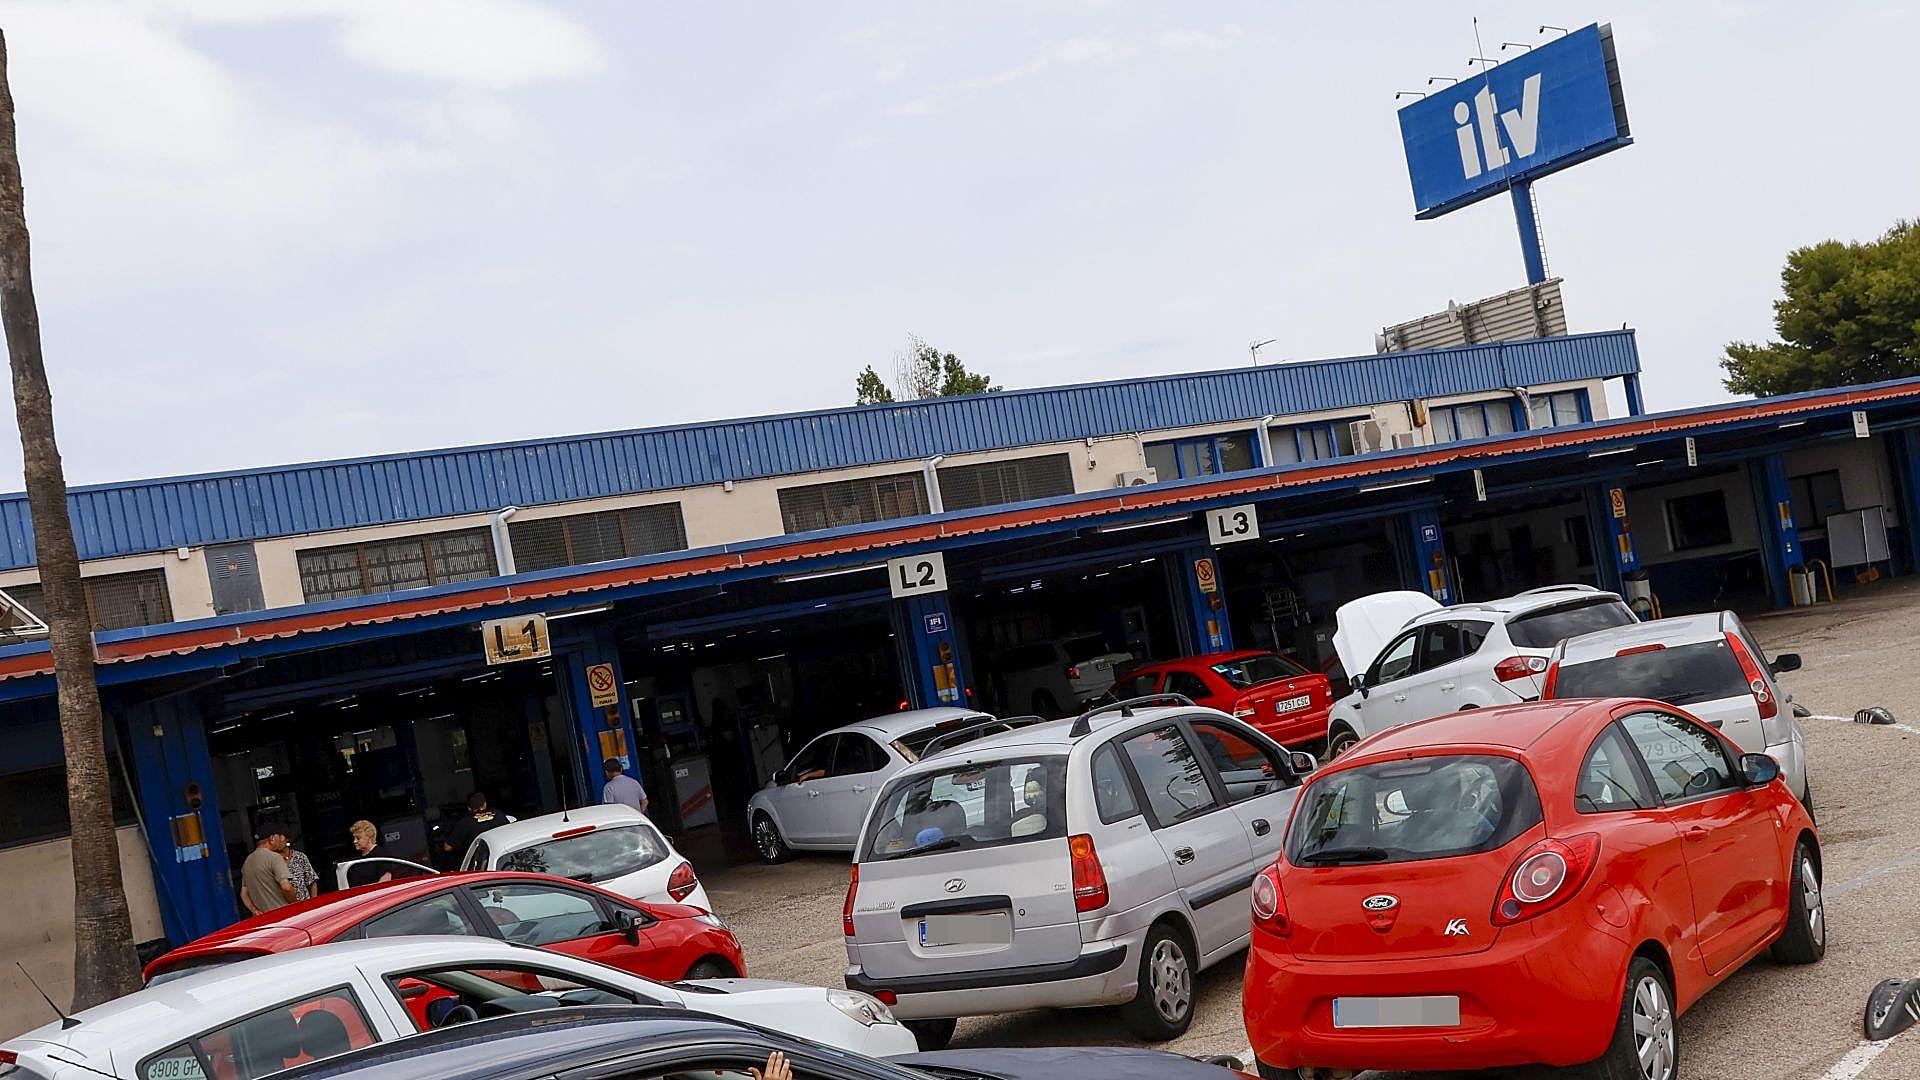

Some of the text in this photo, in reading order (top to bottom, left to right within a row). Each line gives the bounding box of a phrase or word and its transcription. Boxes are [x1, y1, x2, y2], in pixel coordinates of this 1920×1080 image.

[1453, 72, 1542, 180] itv
[1218, 511, 1250, 537] L3
[898, 561, 936, 589] L2
[494, 619, 539, 656] L1
[1367, 896, 1390, 909] Ford
[150, 1060, 180, 1078] 3908
